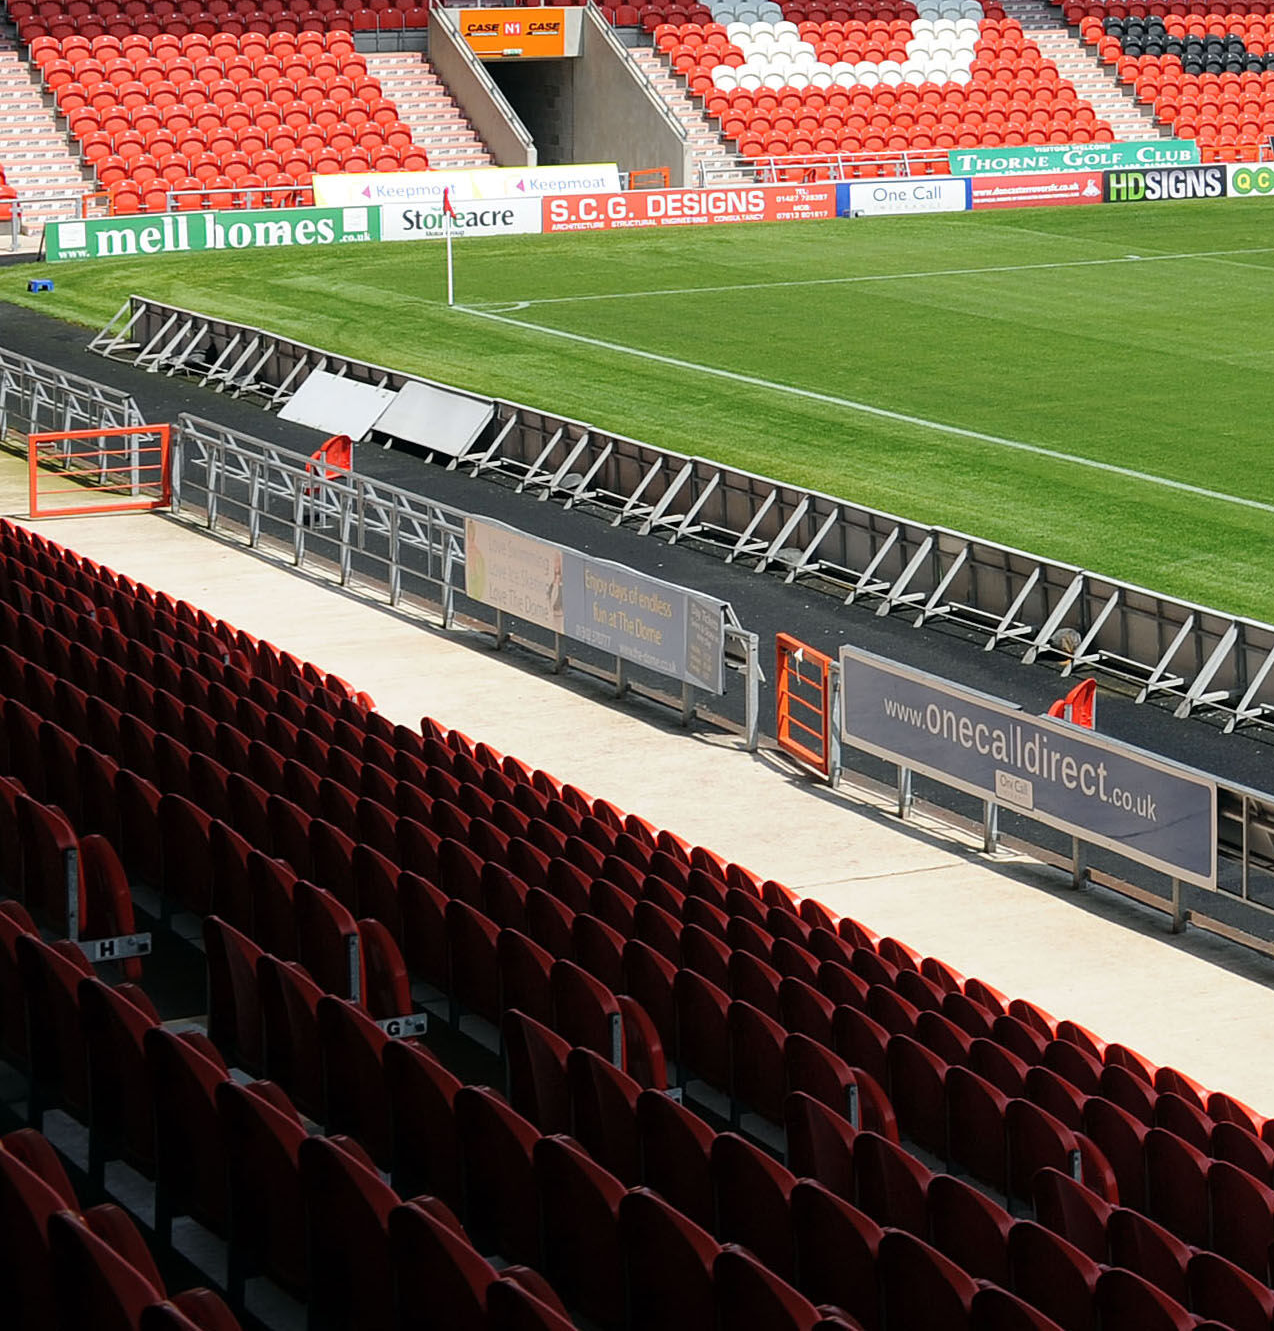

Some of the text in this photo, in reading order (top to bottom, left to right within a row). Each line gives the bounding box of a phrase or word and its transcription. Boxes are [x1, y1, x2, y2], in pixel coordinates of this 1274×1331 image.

[468, 23, 501, 32] CASE
[504, 22, 521, 35] N1
[529, 22, 561, 31] CASE
[957, 154, 1049, 172] THORNE
[1063, 150, 1123, 167] GOLF
[1136, 146, 1191, 163] CLUB
[530, 177, 606, 193] Keepmoat
[873, 185, 942, 202] One Call
[1109, 169, 1223, 201] HDSIGNS
[551, 191, 766, 223] S.C.G. DESIGNS
[612, 218, 658, 228] STRUCTURAL
[714, 213, 766, 224] CONSULTANCY
[96, 213, 334, 258] mell homes
[339, 231, 371, 244] .co.uk
[58, 249, 91, 261] www.
[584, 570, 608, 599] Enjoy
[608, 578, 631, 605] days
[639, 587, 673, 619] endless
[618, 611, 663, 647] The Dome
[884, 698, 1157, 822] www.onecalldirect.co.uk
[100, 941, 114, 958] H
[387, 1019, 401, 1037] G
